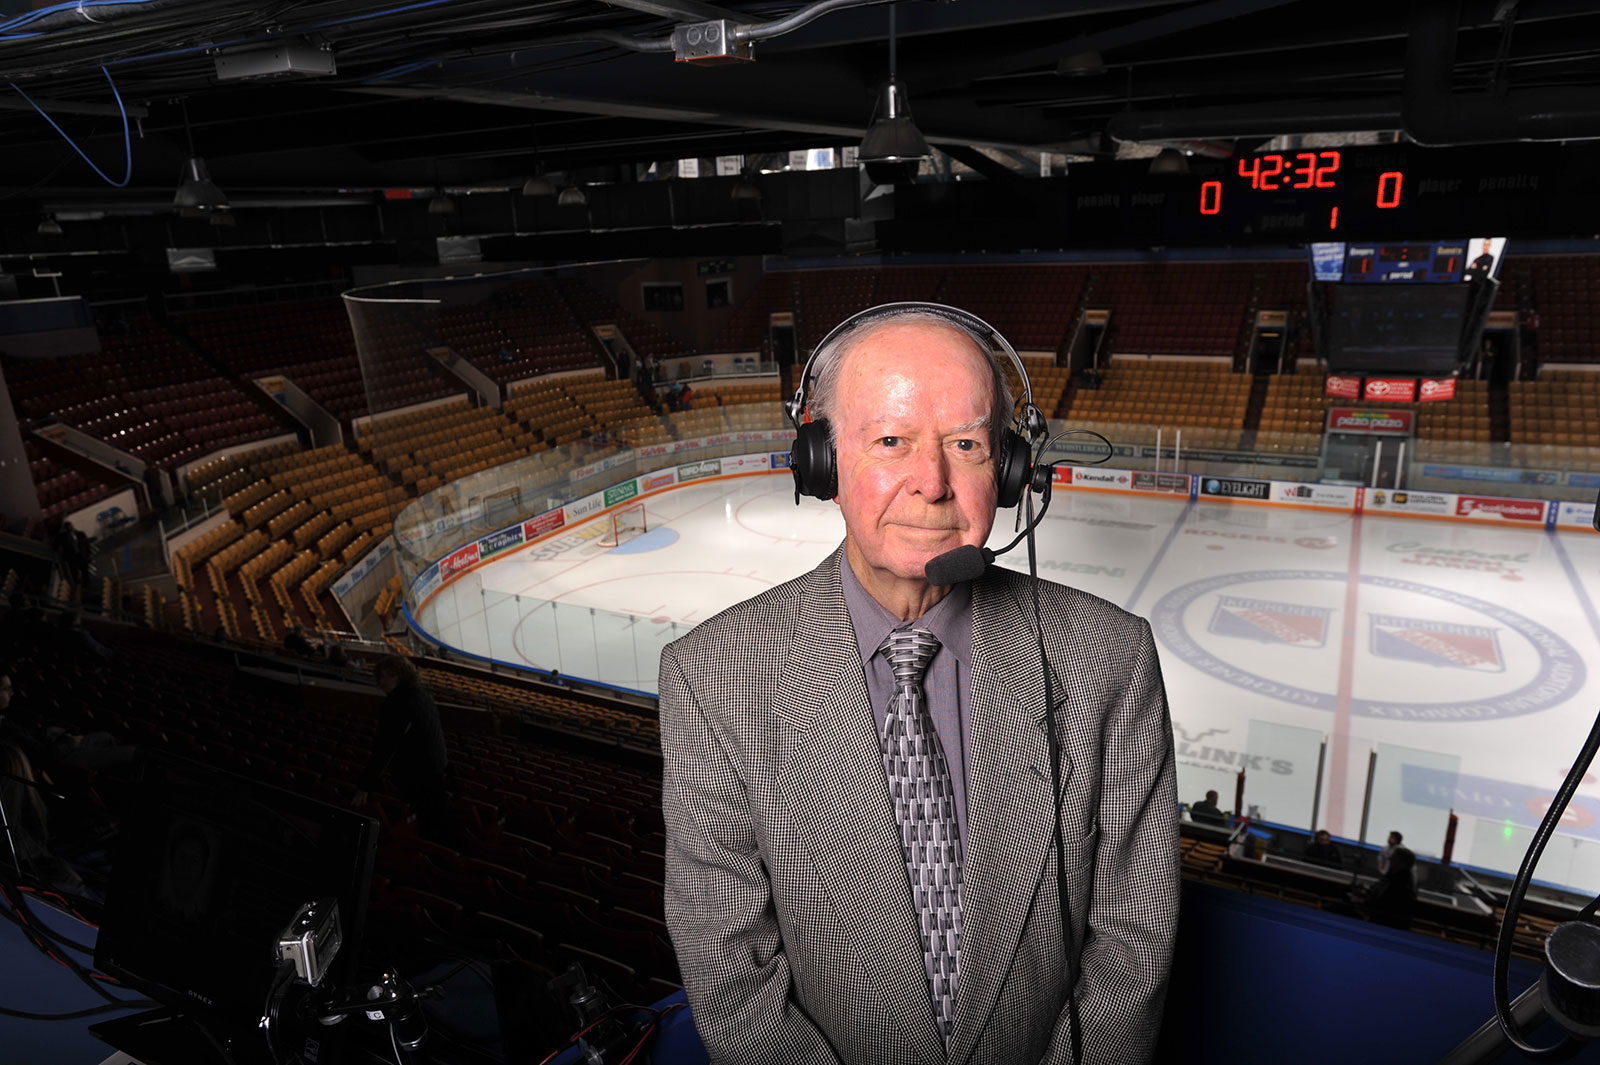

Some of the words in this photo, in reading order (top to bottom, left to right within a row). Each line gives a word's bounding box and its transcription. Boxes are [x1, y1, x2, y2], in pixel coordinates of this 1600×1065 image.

[1238, 151, 1340, 190] 42:32
[1376, 171, 1404, 208] 0
[1417, 176, 1463, 196] player
[1477, 173, 1540, 194] penalty
[1076, 193, 1121, 210] penalty
[1130, 192, 1168, 209] player
[1200, 181, 1222, 214] 0
[1260, 212, 1306, 231] period
[1330, 206, 1339, 229] 1
[1083, 474, 1115, 482] Kendall
[572, 506, 587, 515] Sun
[588, 499, 602, 511] Life
[1476, 503, 1540, 516] Scotiabank
[530, 517, 616, 561] SUBWA
[1184, 528, 1287, 543] ROGERS
[1385, 541, 1533, 563] Central
[1400, 558, 1521, 575] MARKET
[1177, 742, 1294, 776] LINK'S
[1426, 783, 1513, 808] BMO
